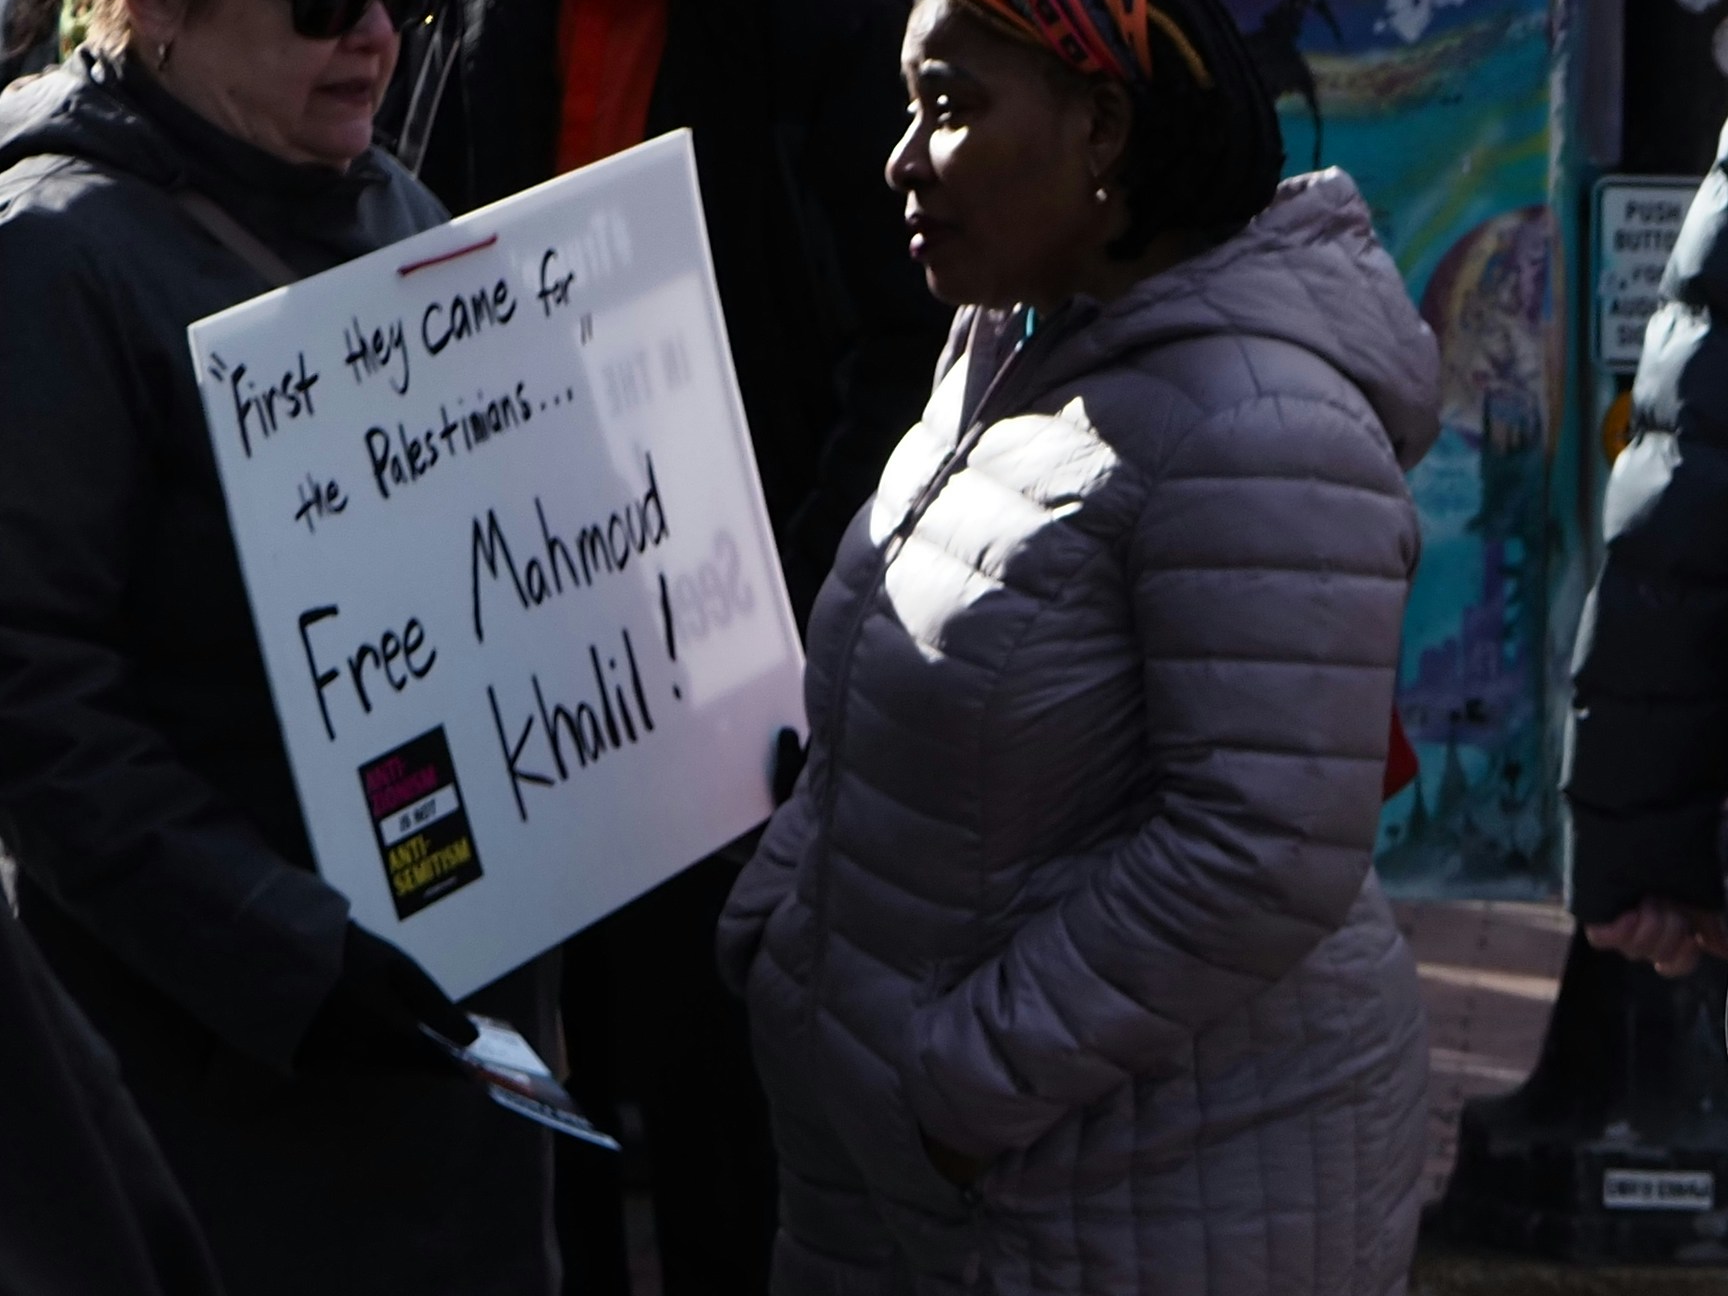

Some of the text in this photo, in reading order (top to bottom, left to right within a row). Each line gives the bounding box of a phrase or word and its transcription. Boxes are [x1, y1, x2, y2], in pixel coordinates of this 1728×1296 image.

[345, 314, 411, 397] they
[420, 275, 520, 357] came
[536, 247, 576, 317] for
[294, 472, 349, 535] the
[297, 449, 671, 742] Free Mahmoud
